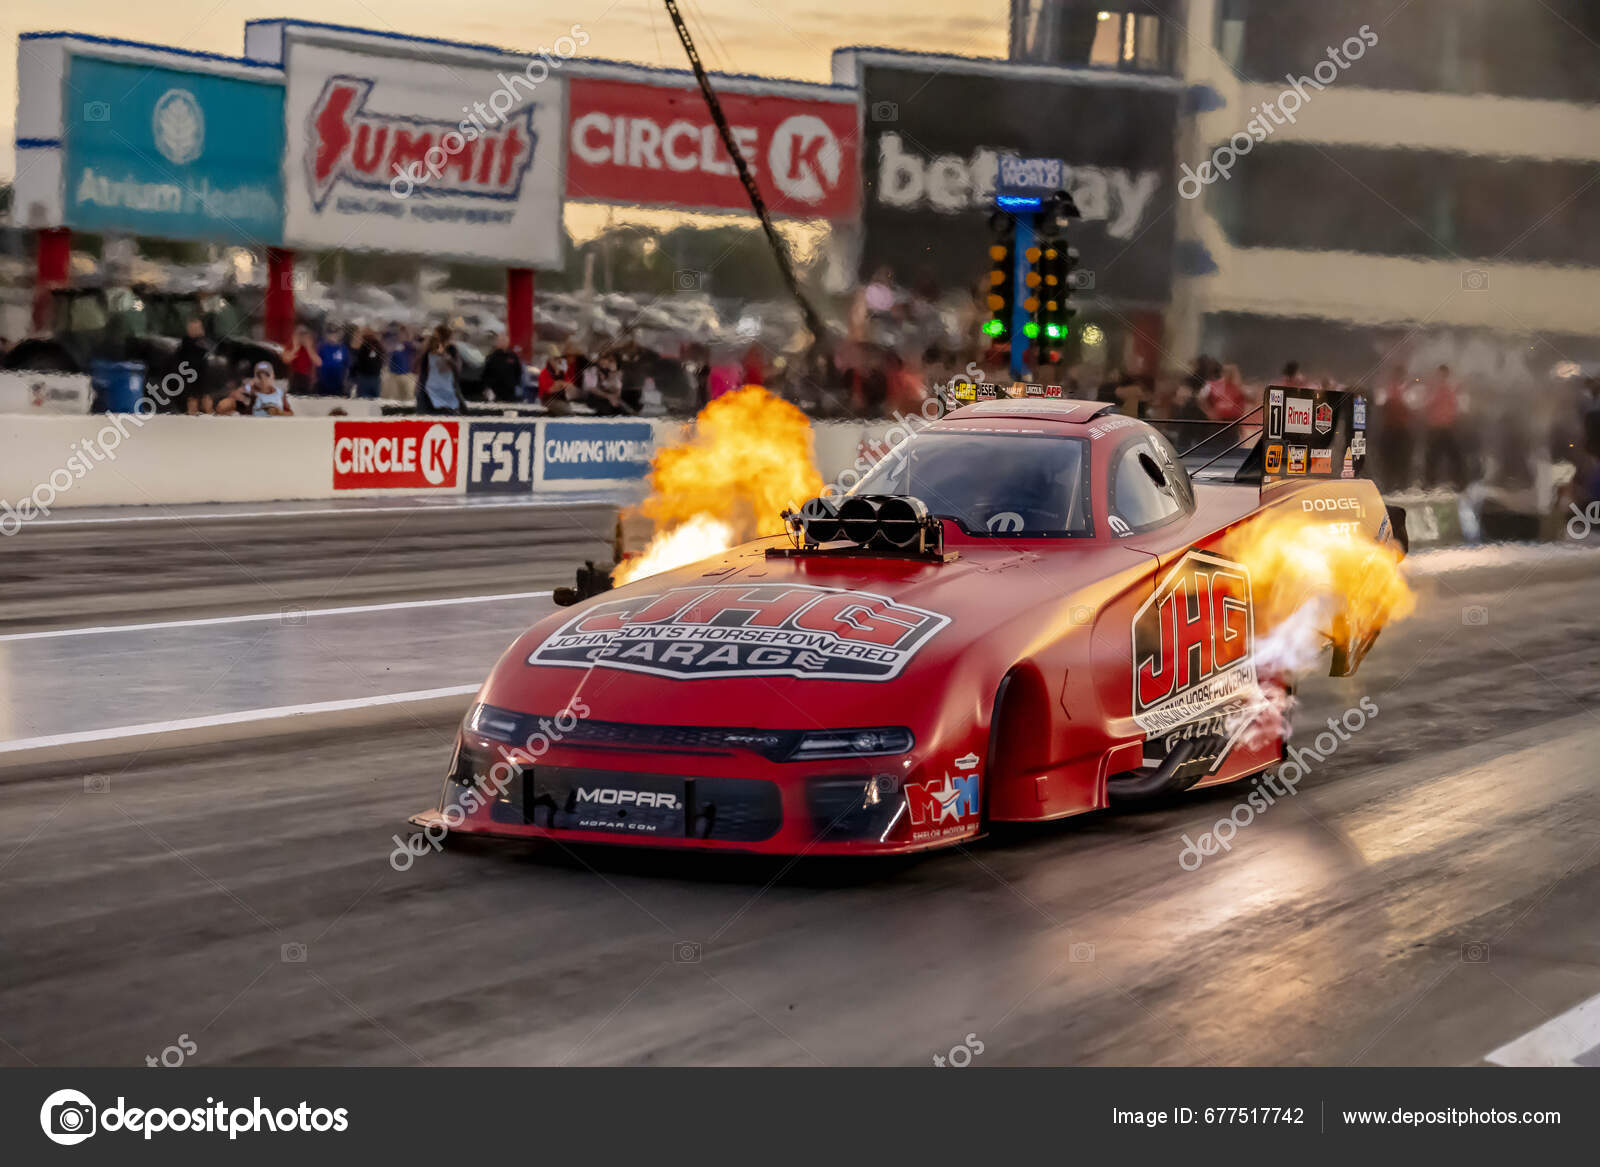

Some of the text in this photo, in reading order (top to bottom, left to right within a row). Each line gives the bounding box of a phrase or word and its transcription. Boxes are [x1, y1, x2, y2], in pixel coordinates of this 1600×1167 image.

[571, 112, 758, 177] CIRCLE
[878, 131, 1161, 240] betay
[1003, 171, 1059, 188] WORLD
[1288, 406, 1311, 426] Rinnai
[335, 437, 416, 473] CIRCLE
[545, 440, 603, 463] CAMPING
[1302, 498, 1360, 512] DODGE
[575, 587, 930, 648] JHG
[586, 641, 829, 670] GARAGE
[687, 627, 899, 663] HORSEPOWERED
[1138, 571, 1247, 709] JHG
[579, 820, 656, 831] MOPAR.COM
